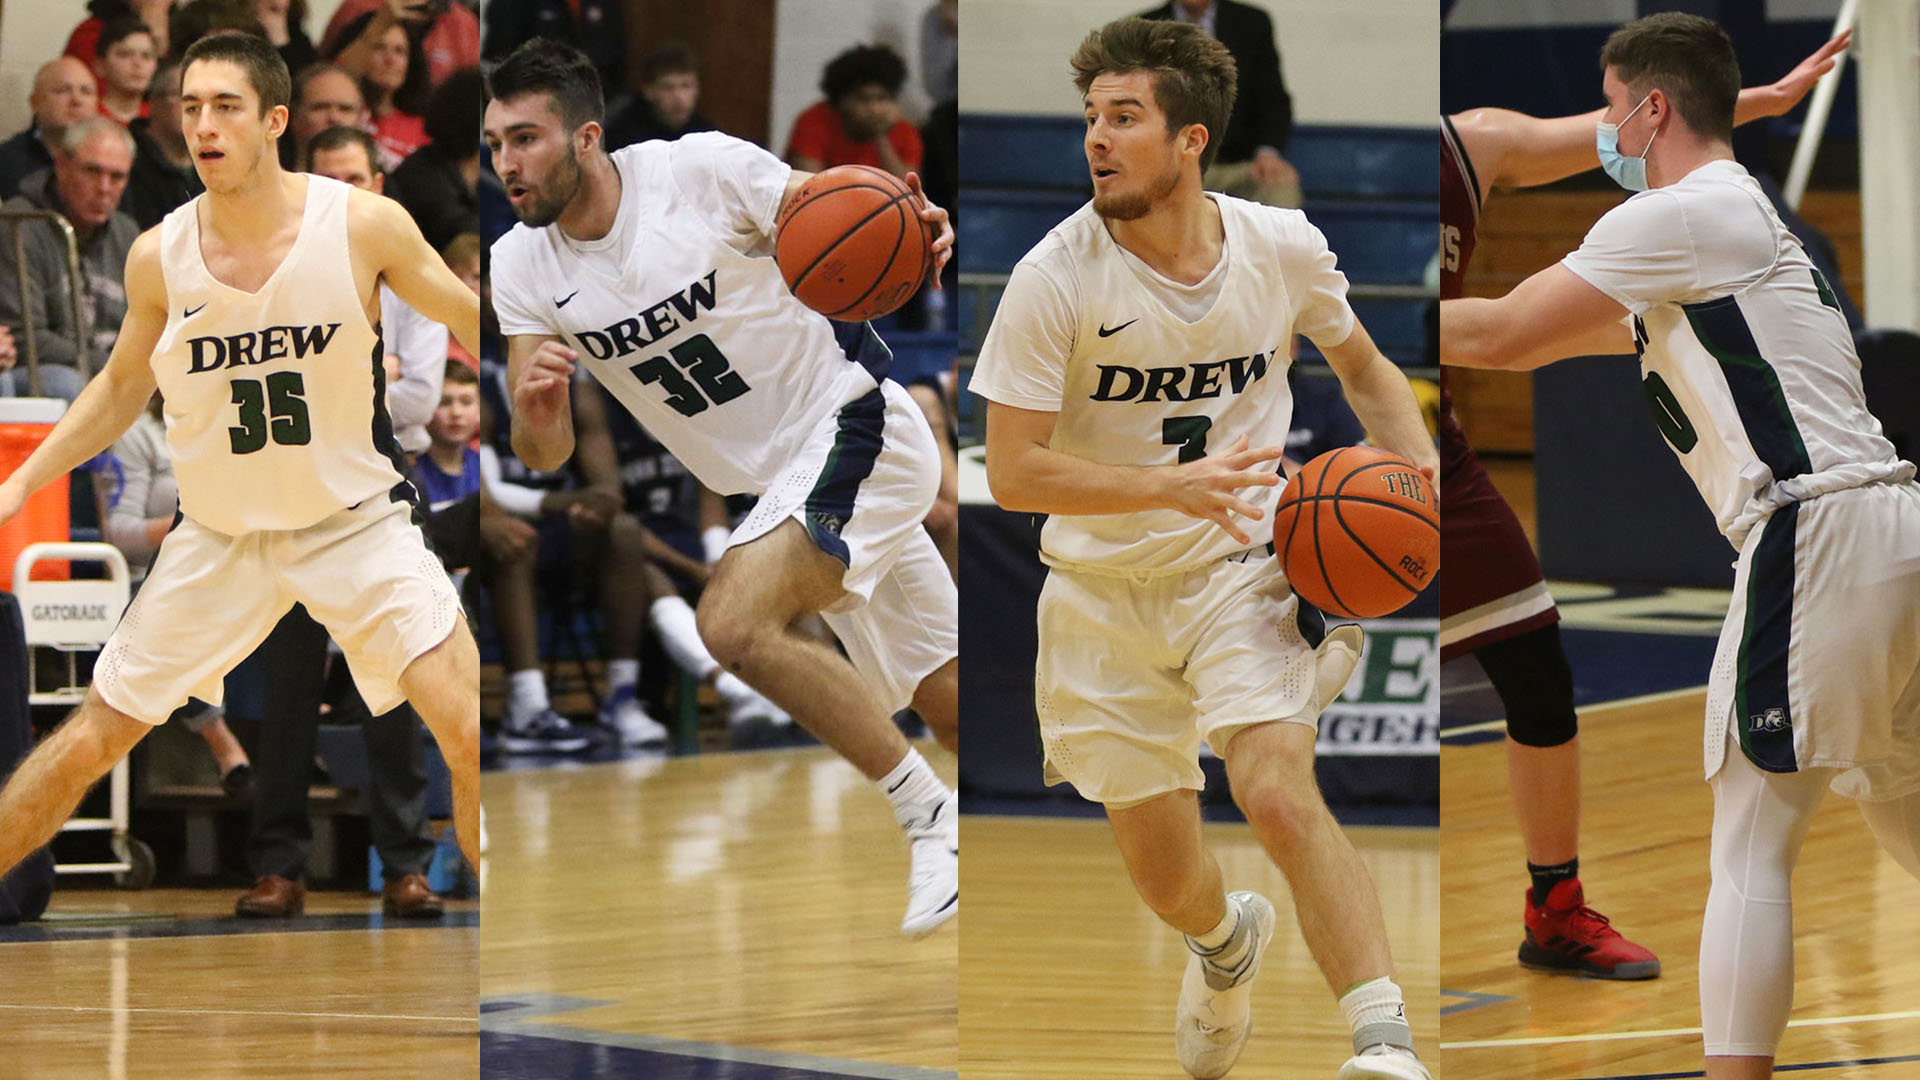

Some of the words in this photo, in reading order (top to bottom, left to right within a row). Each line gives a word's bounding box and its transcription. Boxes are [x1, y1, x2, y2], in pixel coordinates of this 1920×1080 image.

[571, 268, 718, 361] DREW
[186, 322, 343, 375] DREW
[628, 333, 752, 418] 32
[1088, 345, 1280, 405] DREW
[227, 370, 312, 455] 35
[1380, 471, 1427, 505] THE
[1398, 554, 1429, 582] ROCK
[31, 604, 107, 622] GATORADE
